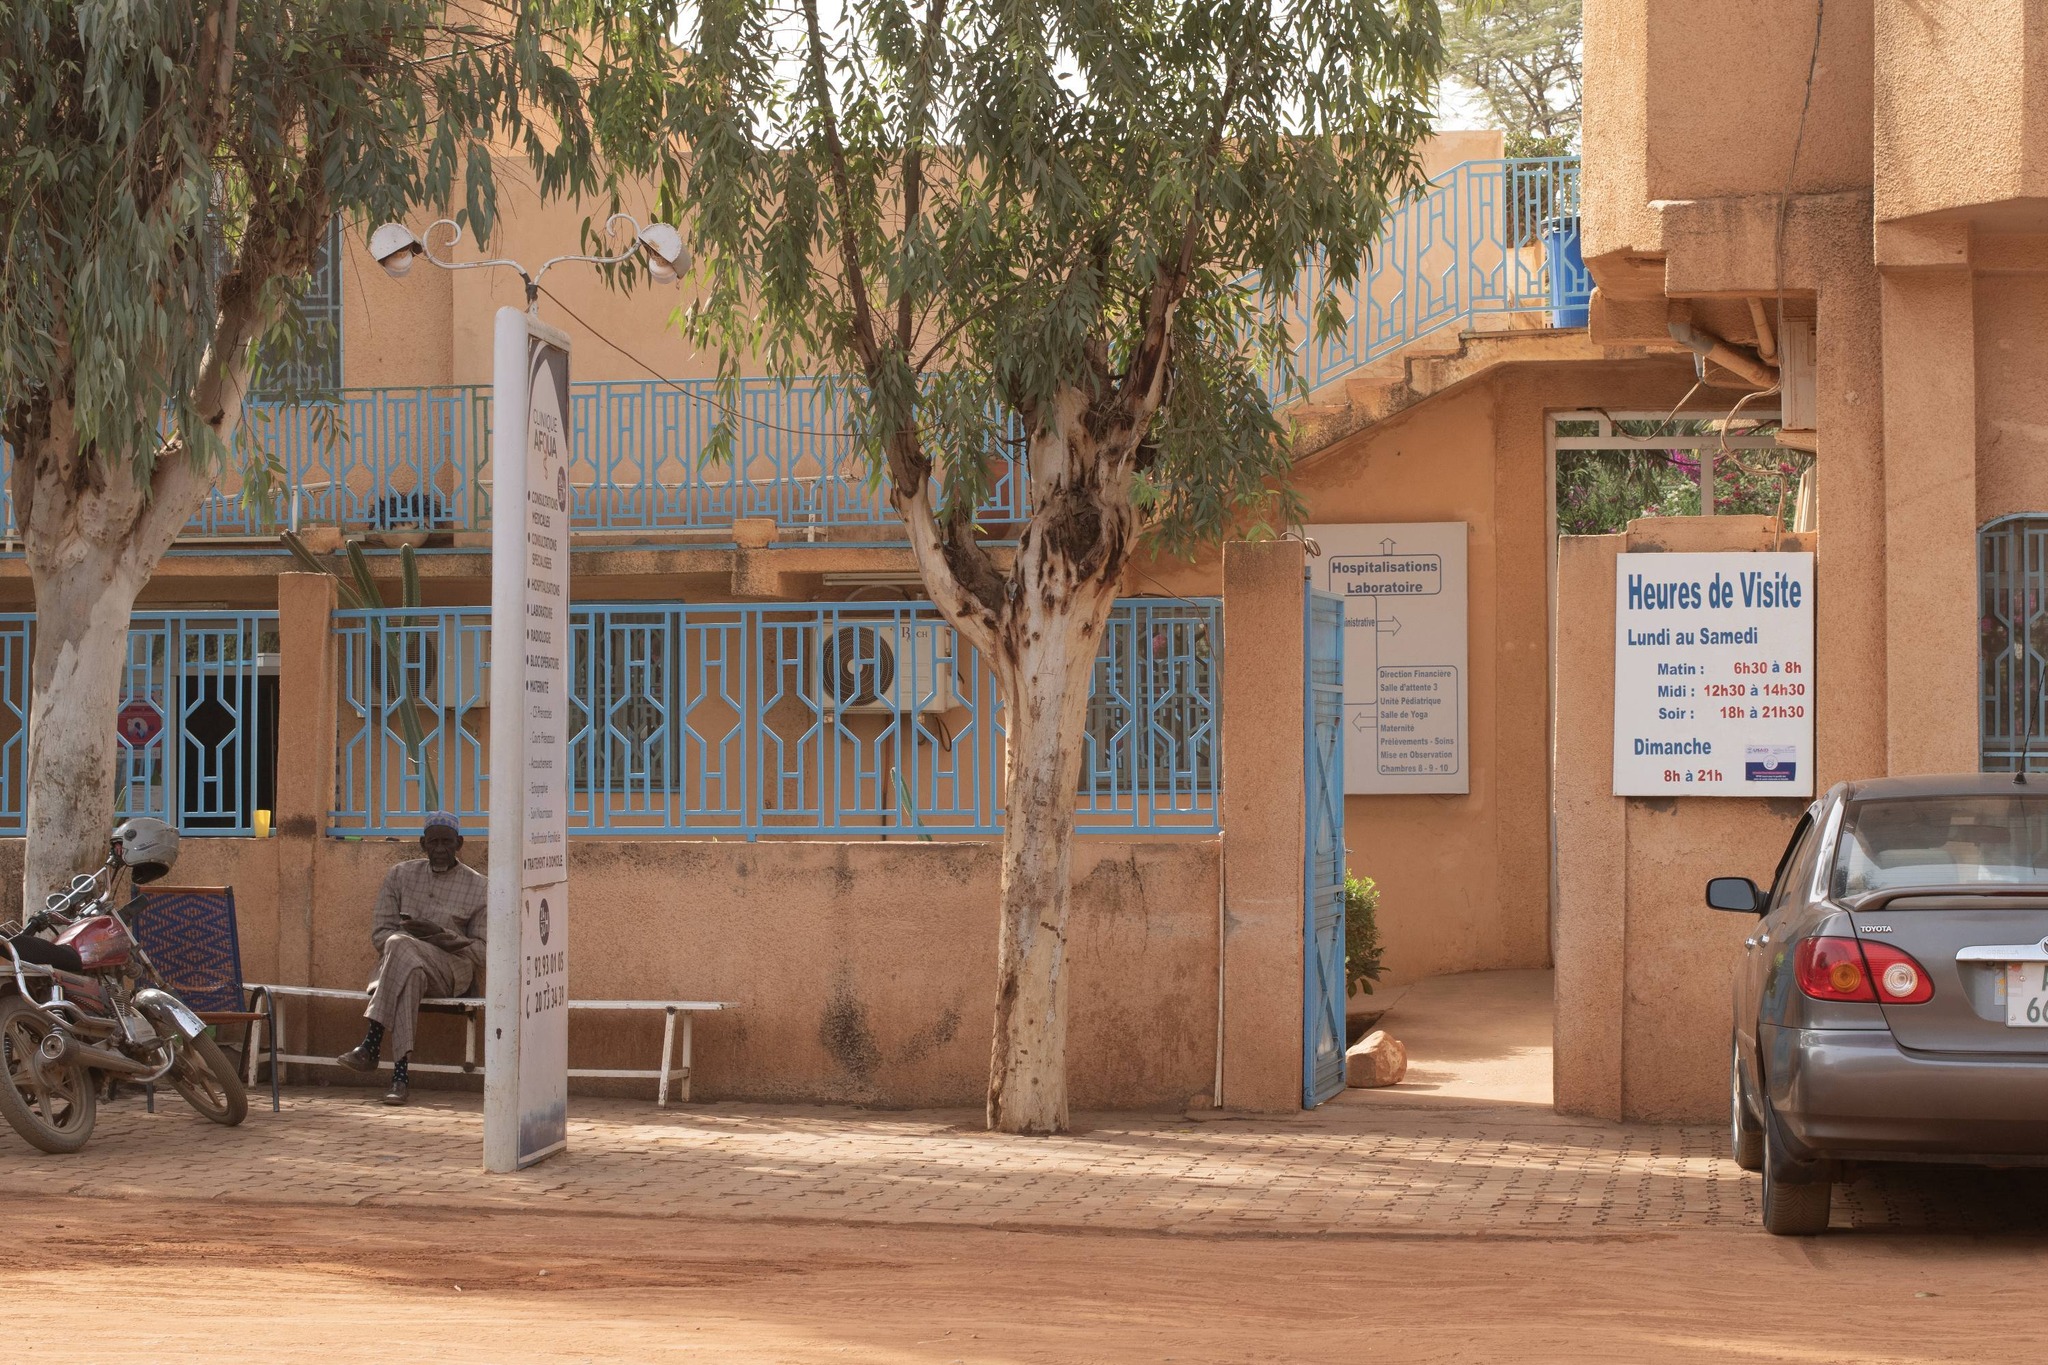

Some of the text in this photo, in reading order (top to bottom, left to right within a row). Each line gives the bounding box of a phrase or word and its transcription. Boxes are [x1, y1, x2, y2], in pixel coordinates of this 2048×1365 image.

[533, 408, 558, 433] CLINIQUE
[1332, 561, 1438, 576] Hospitalisations
[531, 578, 560, 596] HOSPITALISATIONS
[1347, 581, 1423, 593] Laboratoire
[1628, 571, 1802, 610] Heures de Visite
[531, 604, 553, 620] LABORATOIRE
[1344, 617, 1375, 627] inistrative
[530, 629, 552, 644] RADIOLOGIE
[902, 626, 928, 642] RCH
[1628, 627, 1758, 646] Lundi au Samedi
[530, 654, 541, 668] BLOC
[1657, 663, 1696, 675] Matin
[1733, 662, 1768, 674] 6h30
[1771, 660, 1780, 673] à
[1784, 661, 1802, 674] 8h
[1380, 669, 1452, 678] Direction Financière
[1380, 683, 1438, 692] Salle d'attente 3
[1657, 685, 1686, 697] Midi
[1704, 684, 1745, 697] 12h30
[1750, 683, 1759, 696] à
[1763, 683, 1805, 696] 14h30
[1380, 697, 1441, 706] Unité Pédiatrique
[1380, 710, 1428, 719] Salle de Yoga
[1658, 707, 1687, 720] Soir
[1719, 706, 1745, 718] 18h
[1749, 705, 1758, 718] à
[1762, 705, 1804, 718] 21h30
[1380, 724, 1415, 732] Maternité
[1380, 737, 1429, 745] Prélèvements
[1434, 737, 1454, 745] Soins
[1634, 738, 1712, 756] Dimanche
[1380, 751, 1397, 759] Mise
[1410, 751, 1452, 759] Observation
[1381, 764, 1417, 773] Chambres
[1418, 764, 1423, 772] 8
[1429, 764, 1434, 772] 9
[1440, 764, 1449, 772] 10
[1663, 769, 1723, 782] 8h à 21h
[527, 856, 546, 870] TRAITEMENT
[549, 854, 563, 868] DOMICILE
[1860, 925, 1893, 933] TOYOTA
[534, 951, 564, 978] 92 93 01 05
[535, 991, 542, 1013] 20
[551, 986, 558, 1008] 34
